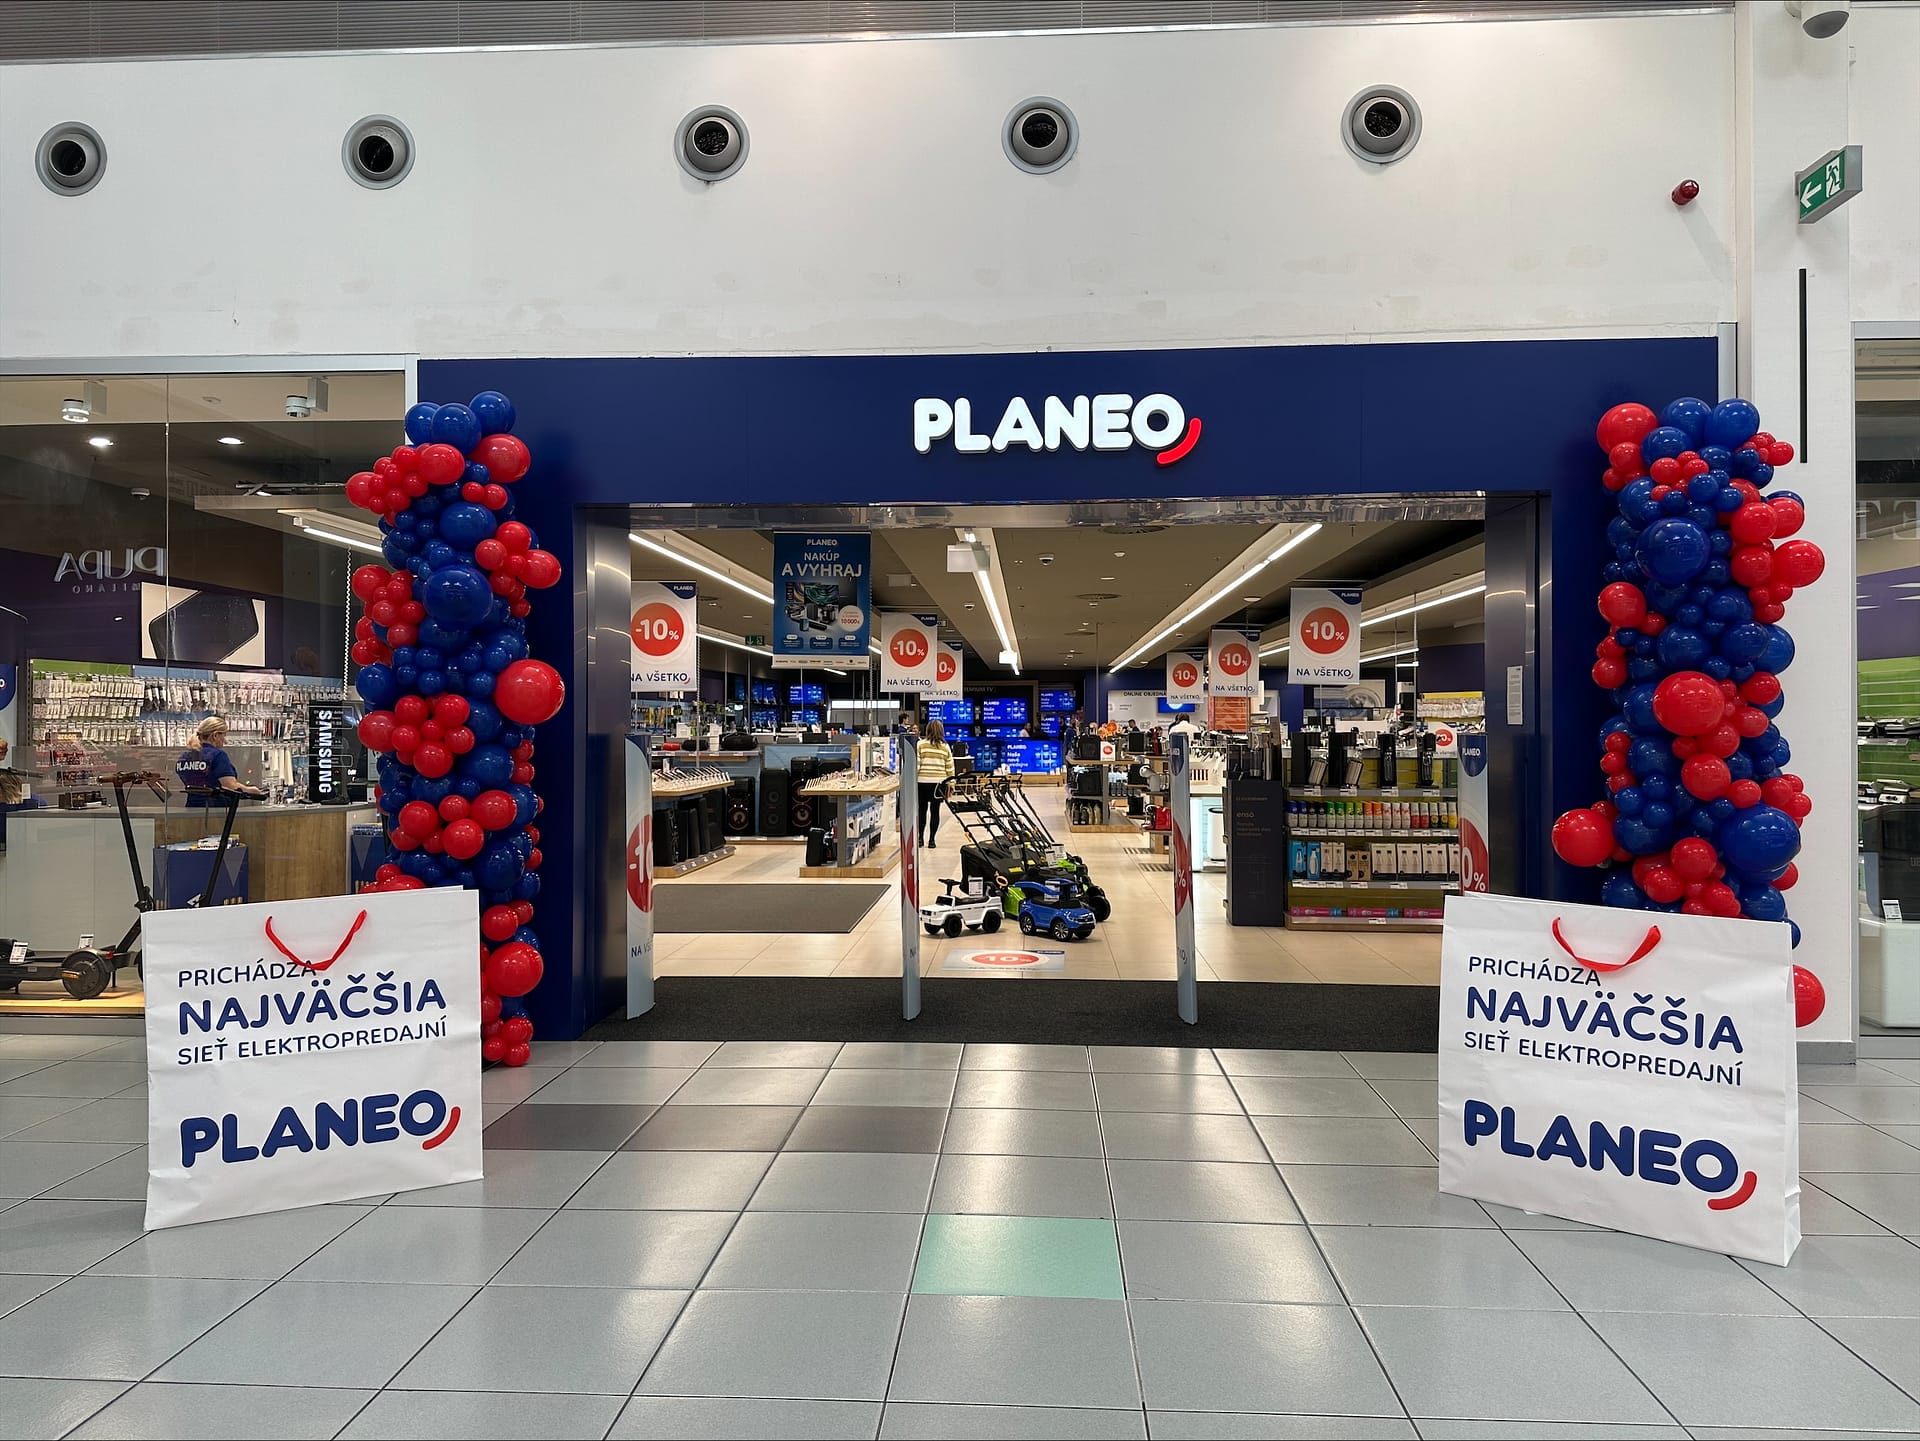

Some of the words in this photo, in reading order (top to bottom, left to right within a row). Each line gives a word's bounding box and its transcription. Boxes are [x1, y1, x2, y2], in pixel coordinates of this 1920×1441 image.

[914, 393, 1186, 453] PLANEO
[806, 538, 838, 546] PLANEO
[804, 550, 840, 561] NAKÚP
[781, 563, 794, 577] A
[796, 563, 863, 578] VYHRAJ
[635, 618, 680, 641] -10%
[1305, 621, 1345, 641] -10%
[893, 640, 925, 657] -10%
[1221, 652, 1247, 666] -10%
[646, 670, 689, 683] VŠETKO
[901, 677, 931, 687] VŠETKO
[1174, 669, 1196, 681] -10%
[1296, 668, 1310, 677] NA
[1313, 667, 1352, 678] VŠETKO
[319, 710, 332, 793] SAMSUNG
[1461, 747, 1481, 757] PLANEO
[176, 761, 207, 771] PLANEO
[178, 958, 317, 988] PRICHÁDZA
[1468, 956, 1602, 987] PRICHÁDZA
[179, 971, 446, 1035] NAJVÄČŠIA
[1467, 986, 1743, 1053] NAJVÄČŠIA
[178, 1037, 228, 1065] SIEŤ
[238, 1015, 447, 1058] ELEKTROPREDAJNÍ
[1464, 1030, 1510, 1053] SIEŤ
[1519, 1038, 1743, 1086] ELEKTROPREDAJNÍ
[180, 1089, 447, 1168] PLANEO
[1464, 1099, 1739, 1193] PLANEO
